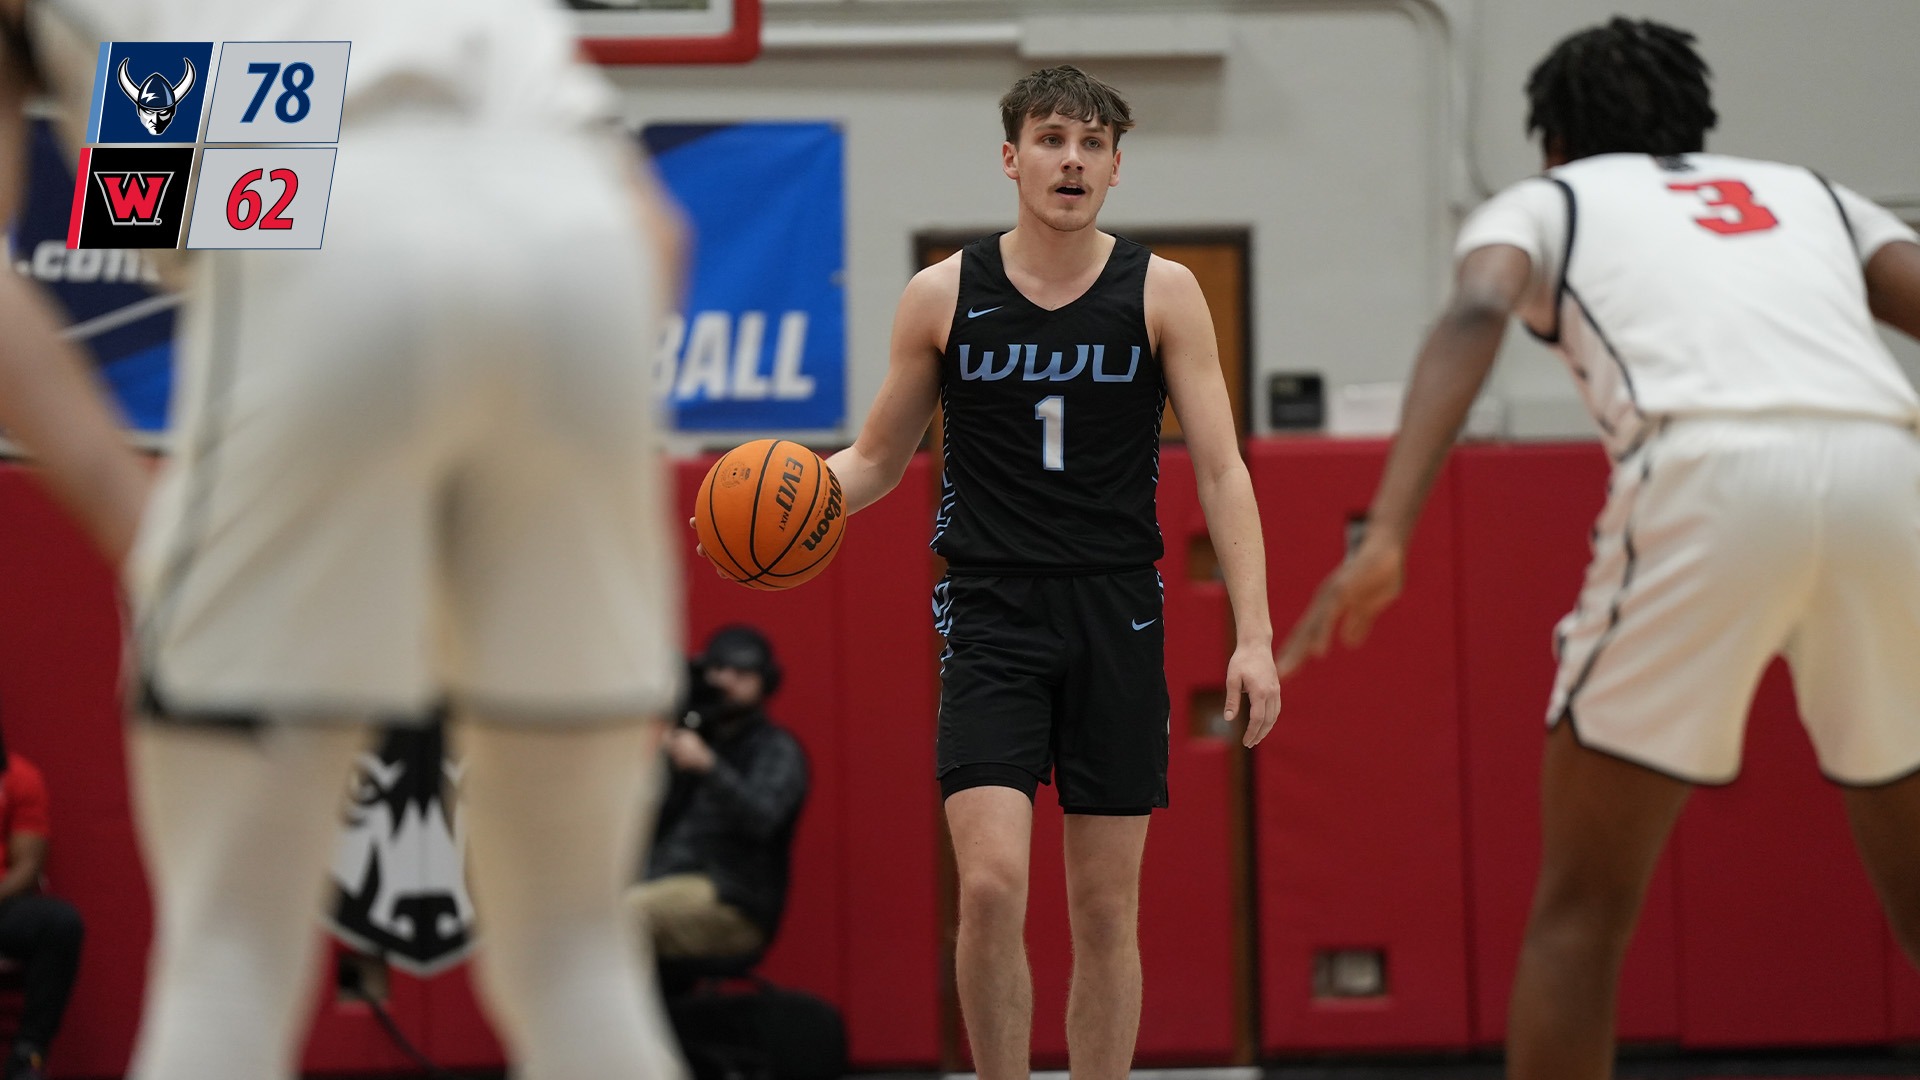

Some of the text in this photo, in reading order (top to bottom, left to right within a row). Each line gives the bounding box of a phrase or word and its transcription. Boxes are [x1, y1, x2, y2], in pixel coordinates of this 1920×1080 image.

[1664, 178, 1780, 236] 3
[959, 344, 1141, 383] WWU
[1034, 395, 1065, 471] 1
[775, 457, 804, 532] EVO NXT
